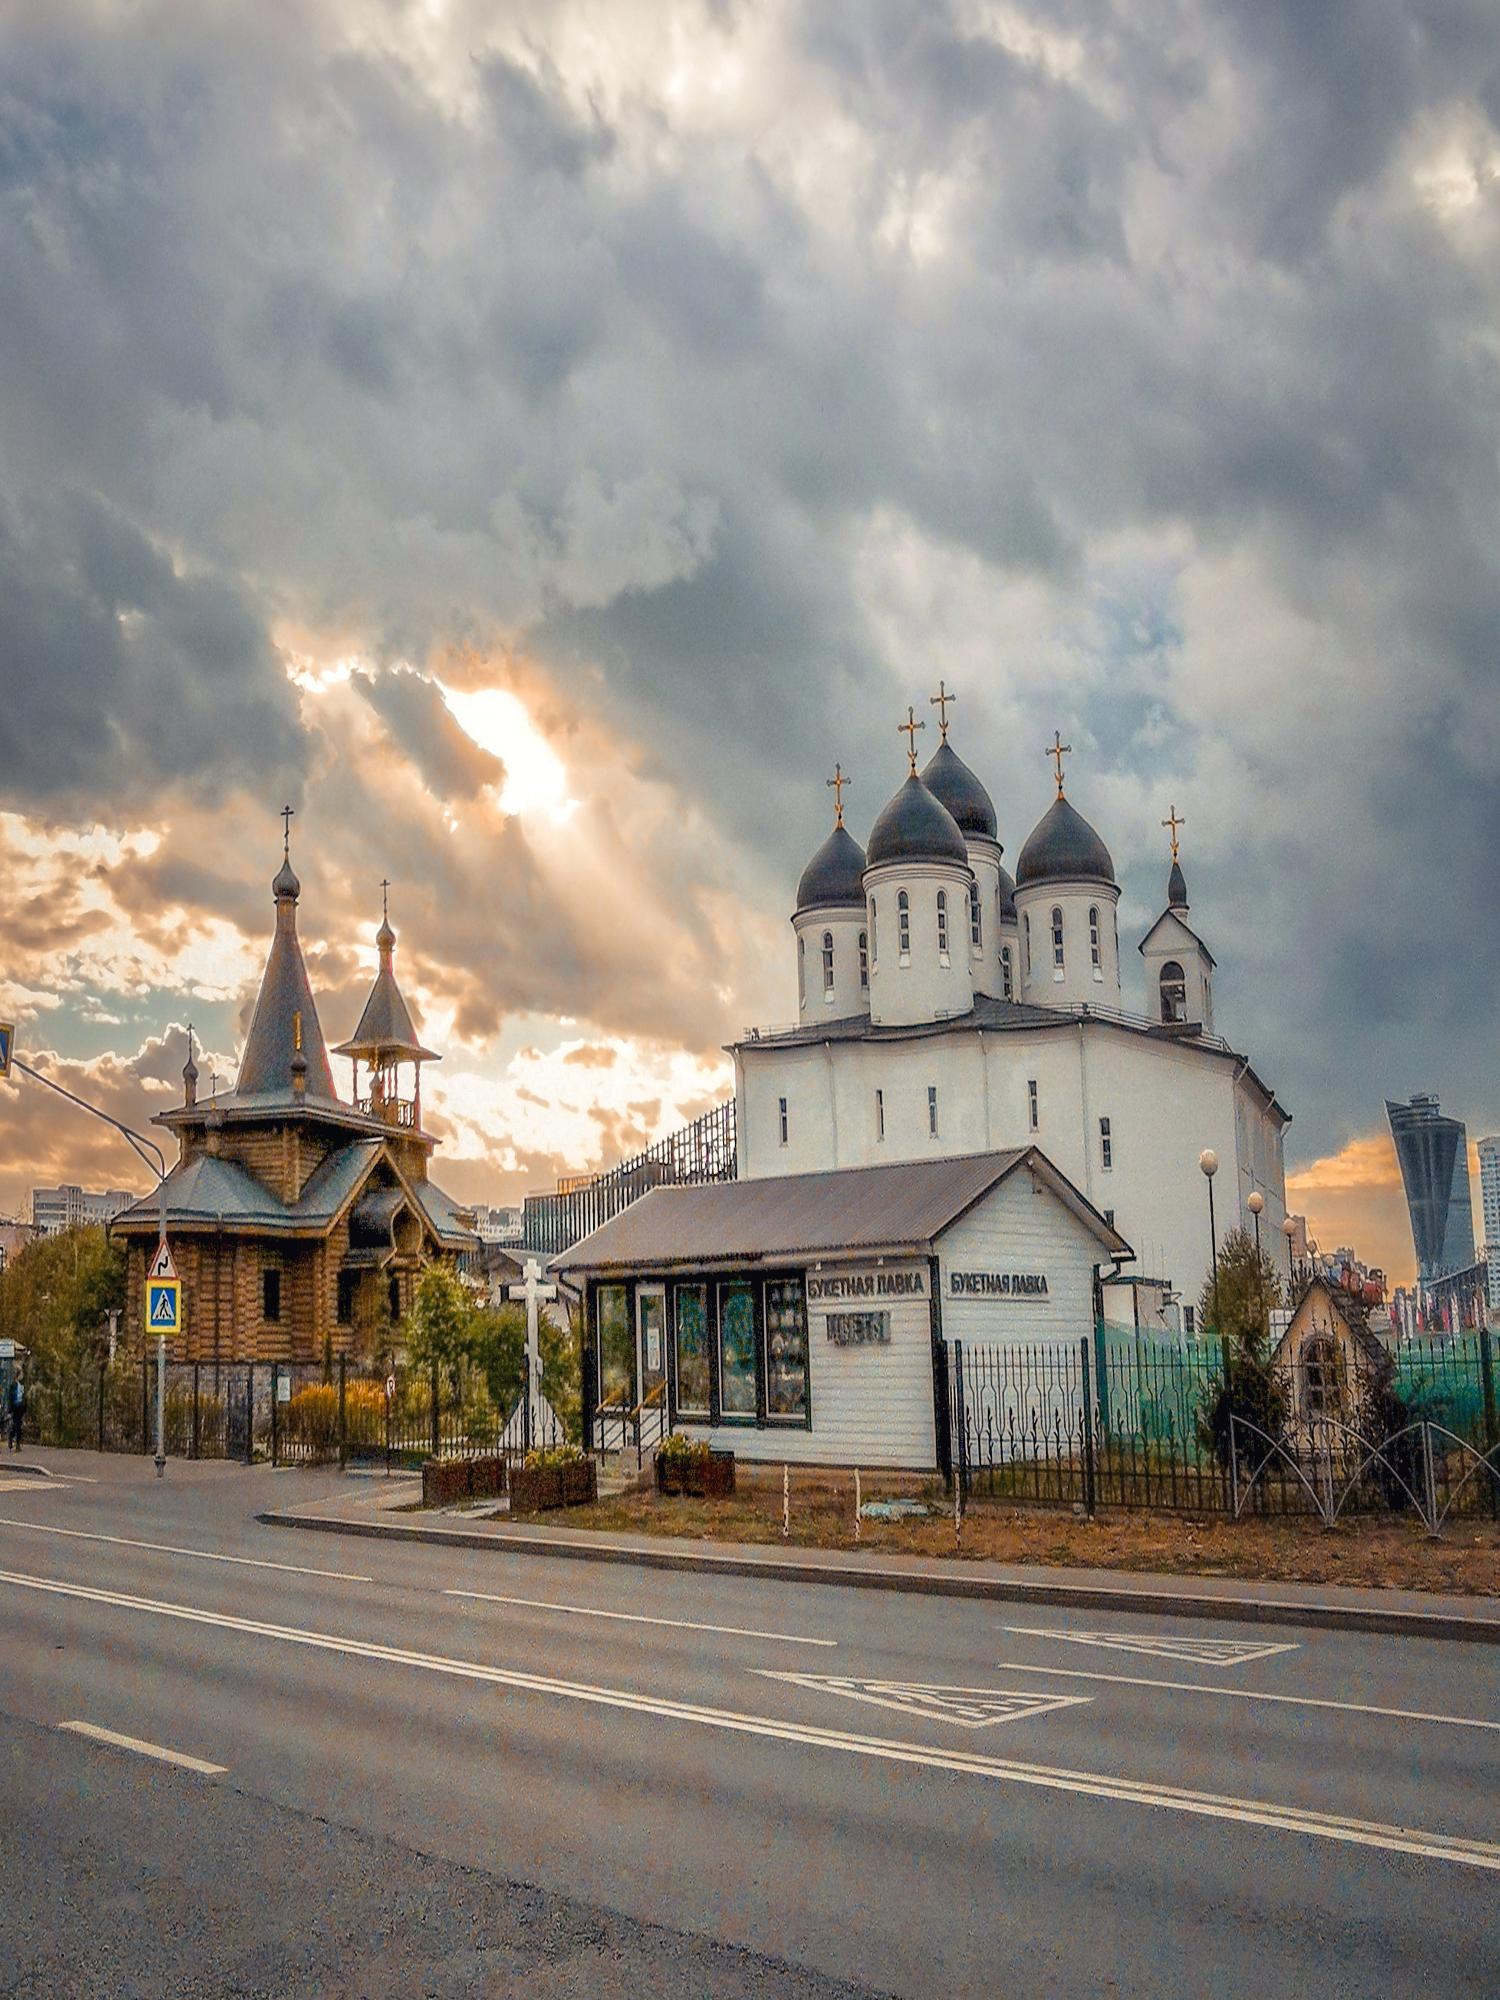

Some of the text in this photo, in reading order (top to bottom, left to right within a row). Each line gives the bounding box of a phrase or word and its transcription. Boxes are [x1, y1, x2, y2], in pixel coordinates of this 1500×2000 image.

[808, 1272, 924, 1298] БУКЕТНАЯ ЛАВКА
[951, 1272, 1049, 1296] БУКЕТНАЯ ЛАВКА
